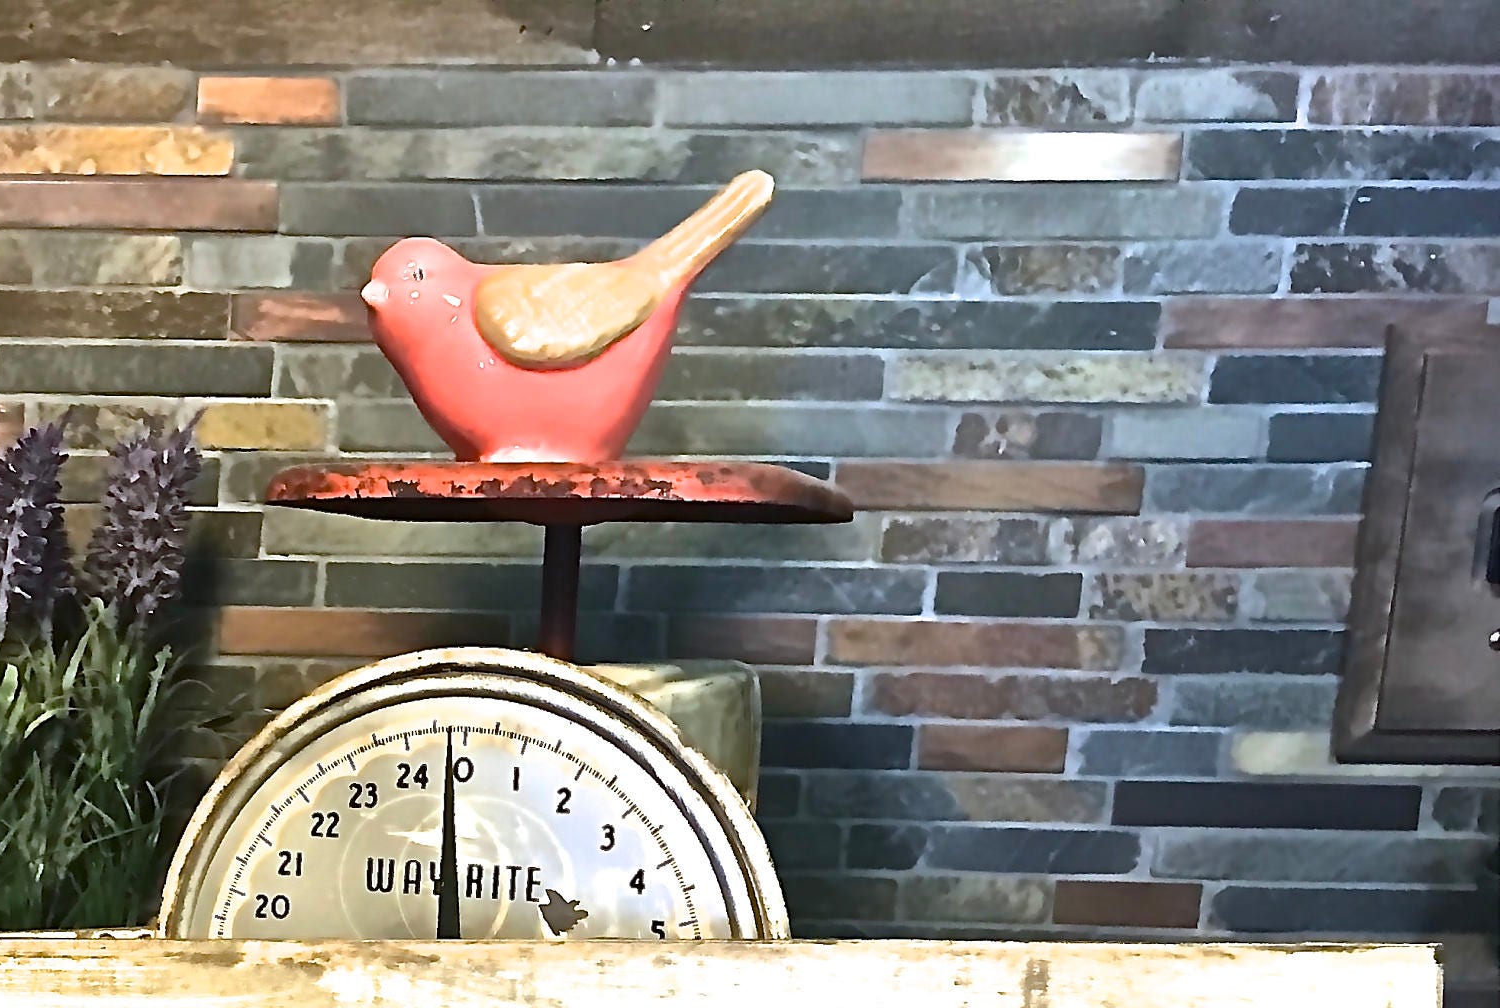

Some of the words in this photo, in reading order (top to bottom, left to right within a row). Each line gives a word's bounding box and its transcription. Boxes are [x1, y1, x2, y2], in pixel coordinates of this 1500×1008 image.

[396, 762, 429, 789] 24
[453, 756, 475, 783] 0
[512, 766, 520, 791] 1
[348, 782, 378, 809] 23
[555, 787, 572, 814] 2
[310, 811, 340, 838] 22
[600, 824, 615, 851] 3
[277, 850, 302, 876] 21
[465, 863, 541, 902] RITE
[629, 868, 646, 895] 4
[255, 894, 290, 919] 20
[650, 919, 666, 941] 5
